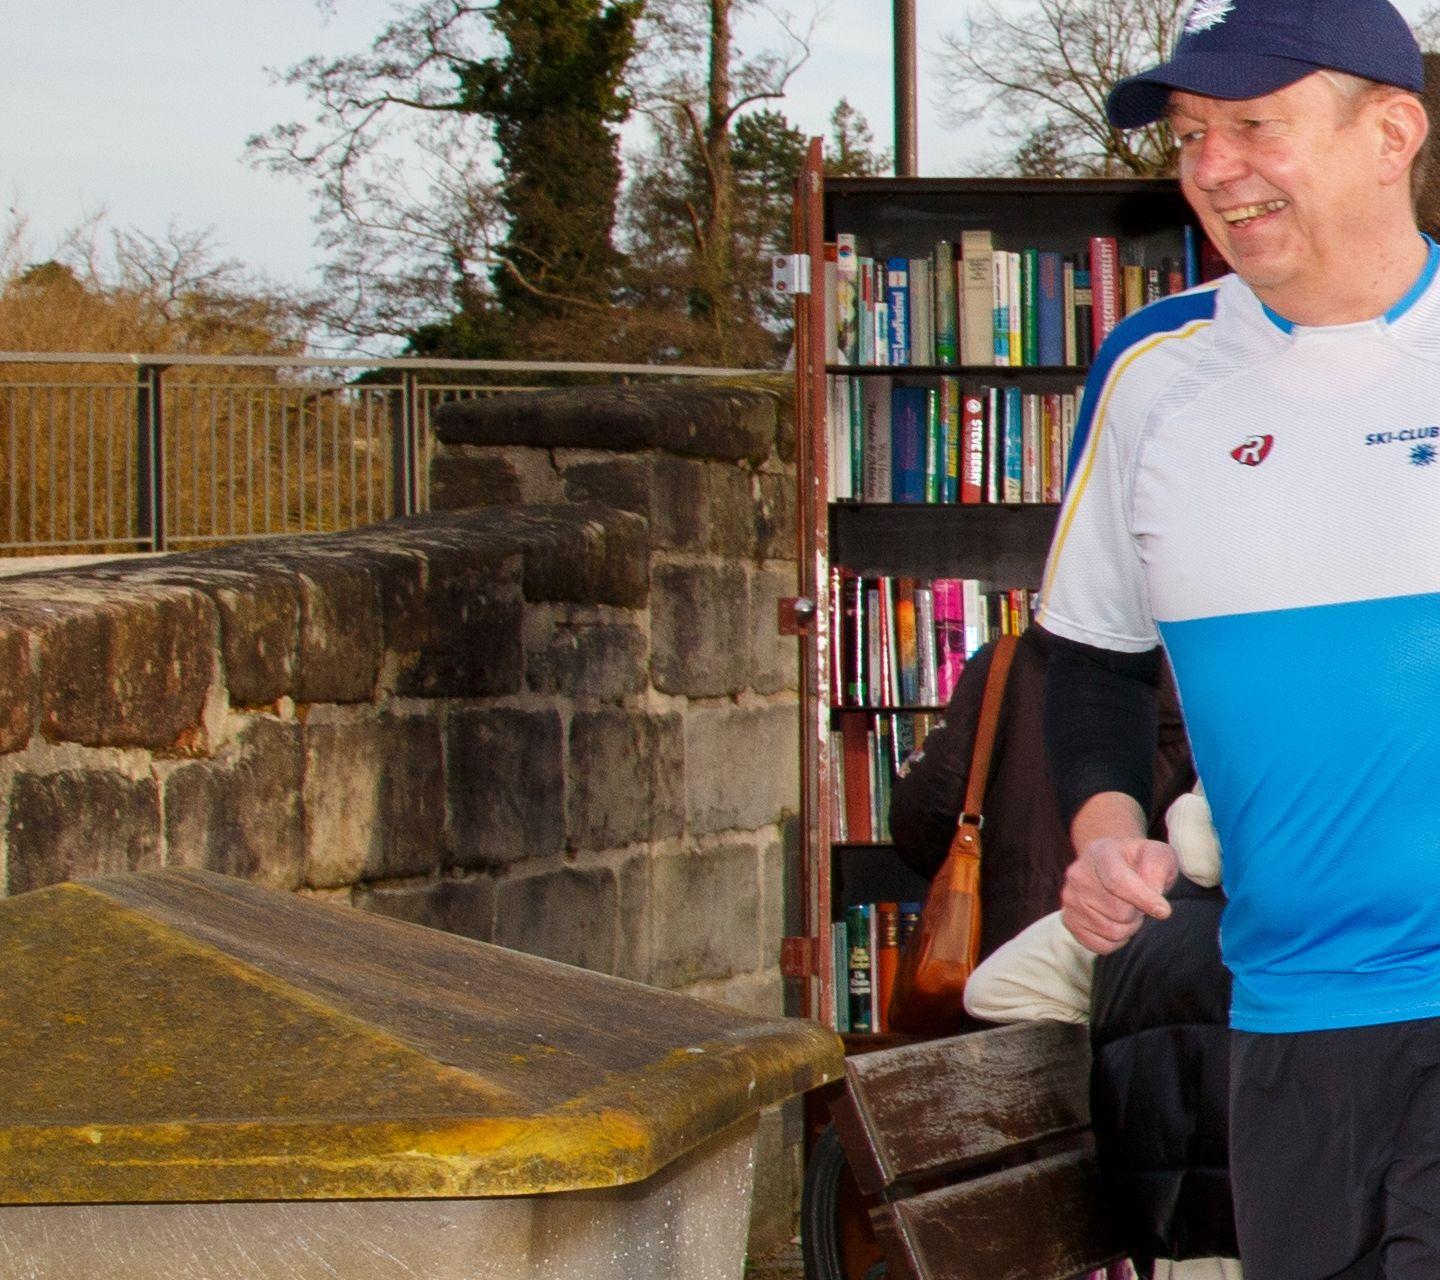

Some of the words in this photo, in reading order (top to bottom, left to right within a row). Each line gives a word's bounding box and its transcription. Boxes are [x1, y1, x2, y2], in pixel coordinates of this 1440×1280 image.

[970, 419, 983, 451] STEVE
[1365, 426, 1440, 445] SKI-CLUB
[969, 452, 983, 487] BERRY
